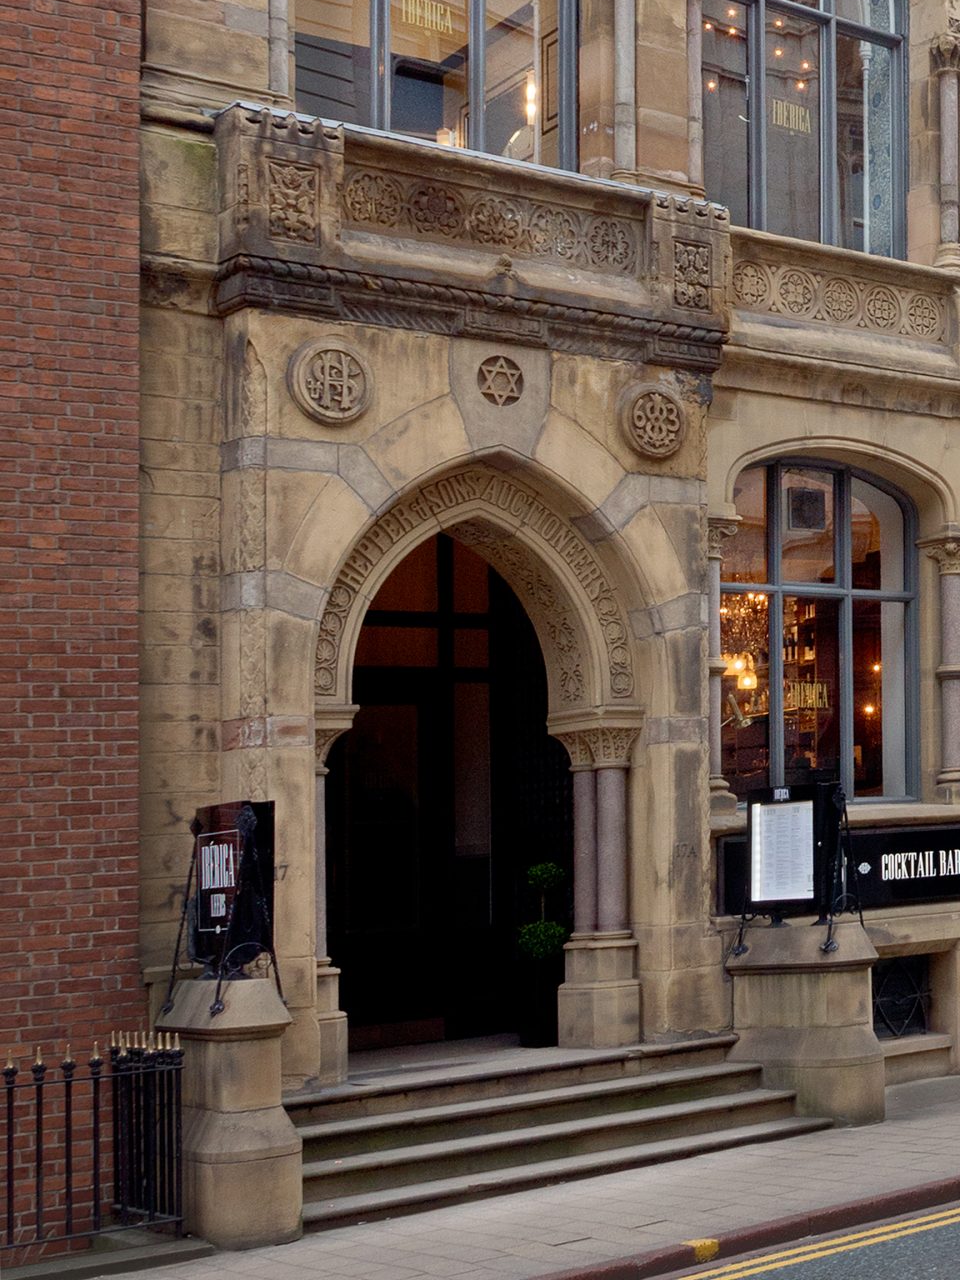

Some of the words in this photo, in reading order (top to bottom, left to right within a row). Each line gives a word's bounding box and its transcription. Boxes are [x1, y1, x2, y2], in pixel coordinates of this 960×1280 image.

[336, 503, 415, 593] HEPPER
[420, 474, 480, 515] SONS
[480, 475, 612, 601] AUCTIONEERS
[201, 841, 236, 890] IBÉRICA
[881, 851, 937, 880] COCKTAIL
